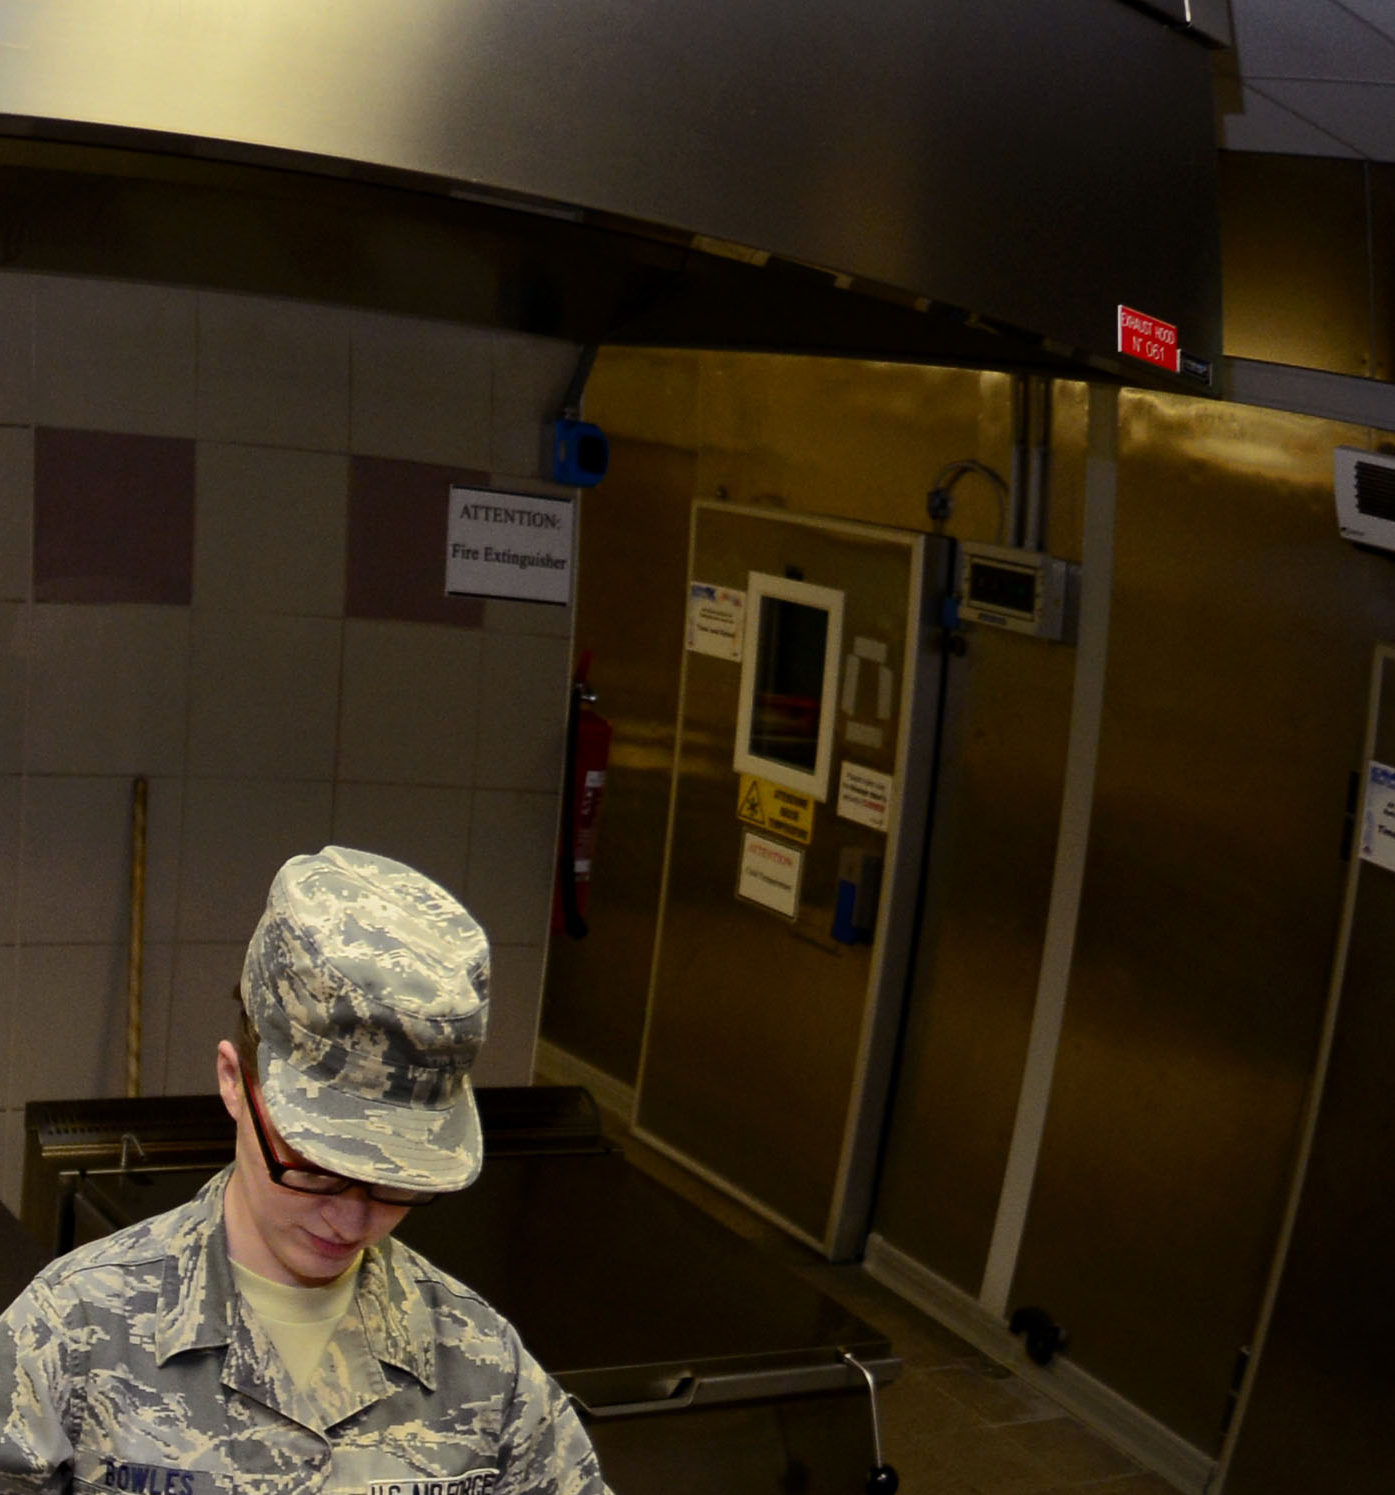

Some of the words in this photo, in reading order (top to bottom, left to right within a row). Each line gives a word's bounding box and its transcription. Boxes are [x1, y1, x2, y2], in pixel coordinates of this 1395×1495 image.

[1121, 312, 1153, 336] EXHAUST
[1154, 326, 1176, 345] HOOD
[1146, 341, 1165, 361] 061
[451, 543, 479, 560] Fire
[483, 546, 567, 570] Extinguisher
